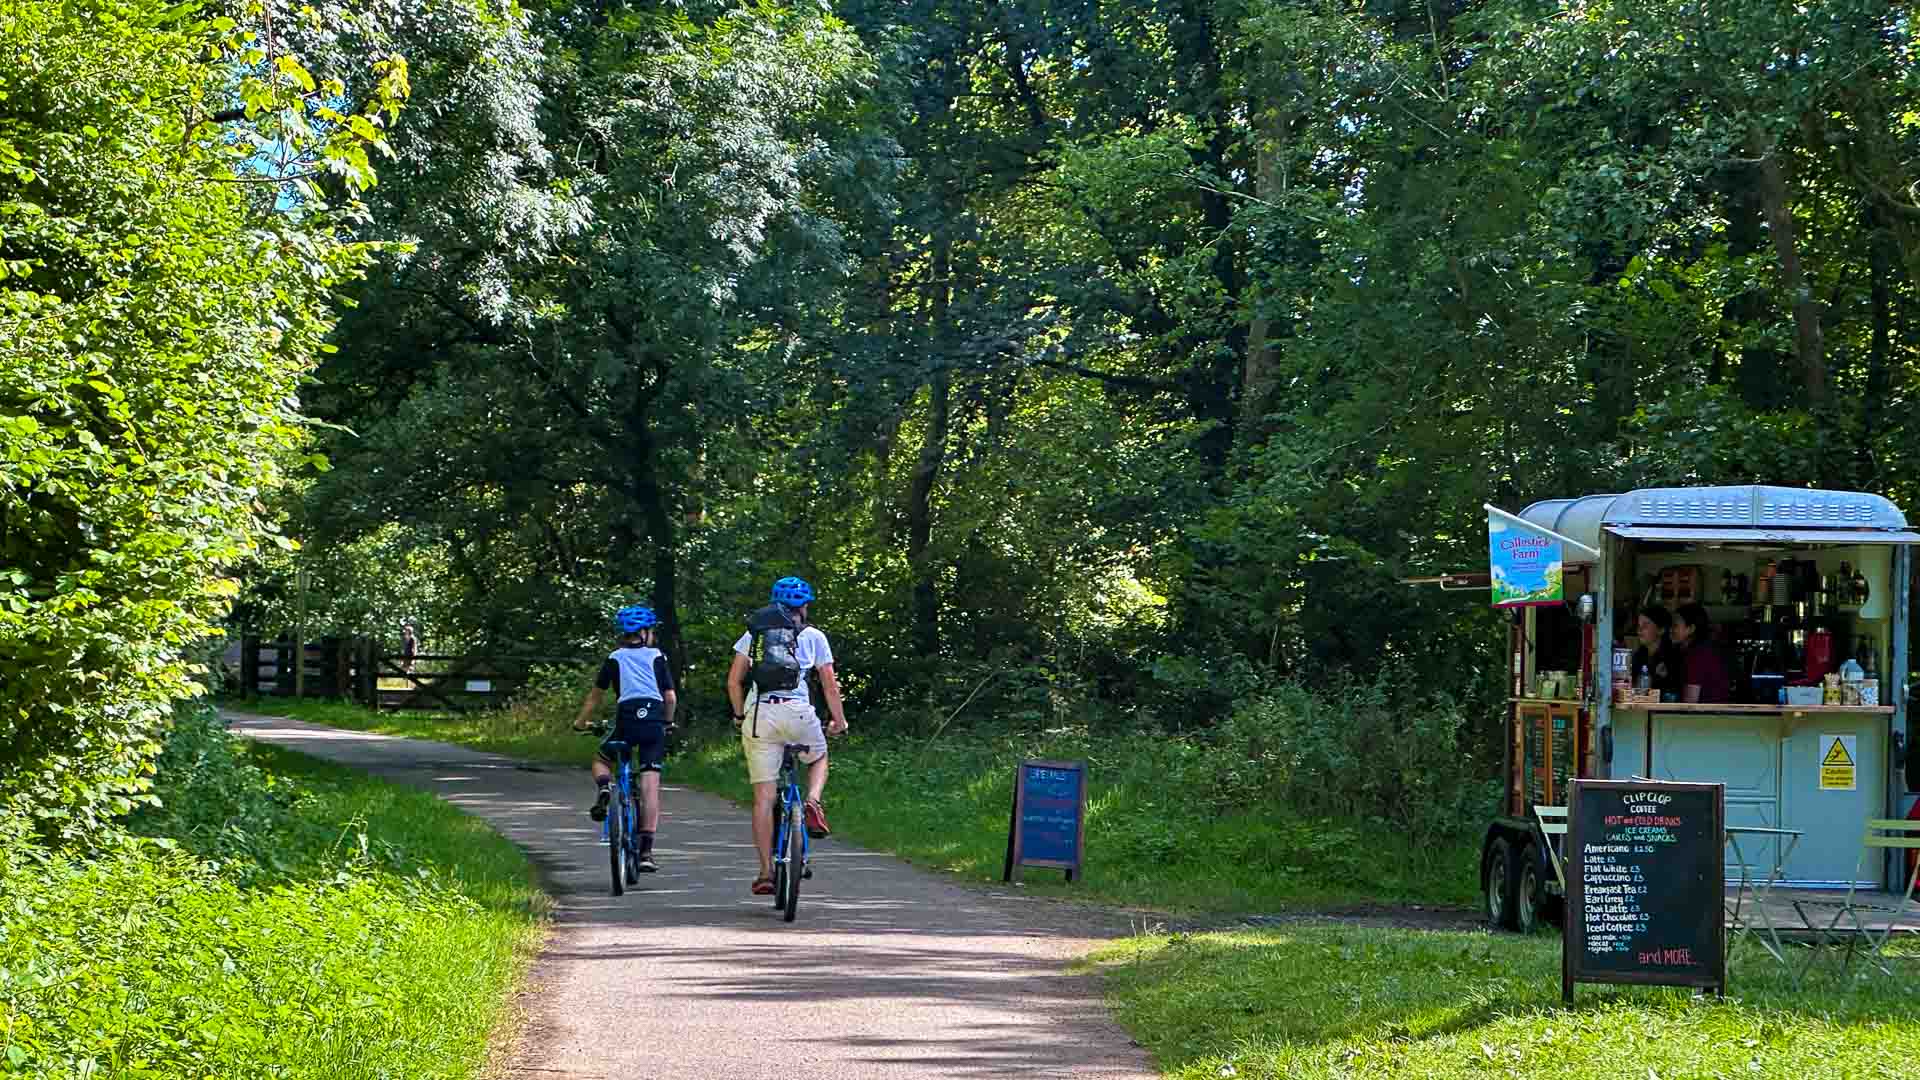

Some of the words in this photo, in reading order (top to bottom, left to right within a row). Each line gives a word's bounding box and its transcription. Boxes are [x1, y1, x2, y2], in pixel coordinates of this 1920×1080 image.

[1513, 549, 1540, 559] Farm
[1623, 792, 1646, 804] CLIP
[1647, 792, 1672, 805] CLOP
[1630, 805, 1657, 814] COFFEE
[1604, 816, 1624, 825] HOT
[1634, 816, 1653, 825] COLD
[1654, 816, 1681, 825] DRINKS
[1606, 834, 1632, 842] CAKES
[1646, 834, 1677, 842] SNACKS
[1584, 843, 1630, 854] Americano
[1584, 855, 1606, 864] Latte
[1584, 864, 1601, 873] Flat
[1602, 864, 1628, 873] White
[1583, 874, 1632, 884] Cappuccino
[1584, 884, 1623, 895] Breakfast
[1622, 884, 1637, 894] Tea
[1585, 895, 1604, 904] Earl
[1604, 895, 1624, 905] Grey
[1584, 904, 1604, 913] Chai
[1604, 903, 1629, 913] Latte
[1585, 913, 1601, 922] Hot
[1601, 913, 1638, 922] Chocolate
[1586, 922, 1605, 932] Iced
[1605, 923, 1634, 932] Coffee
[1639, 946, 1662, 965] and
